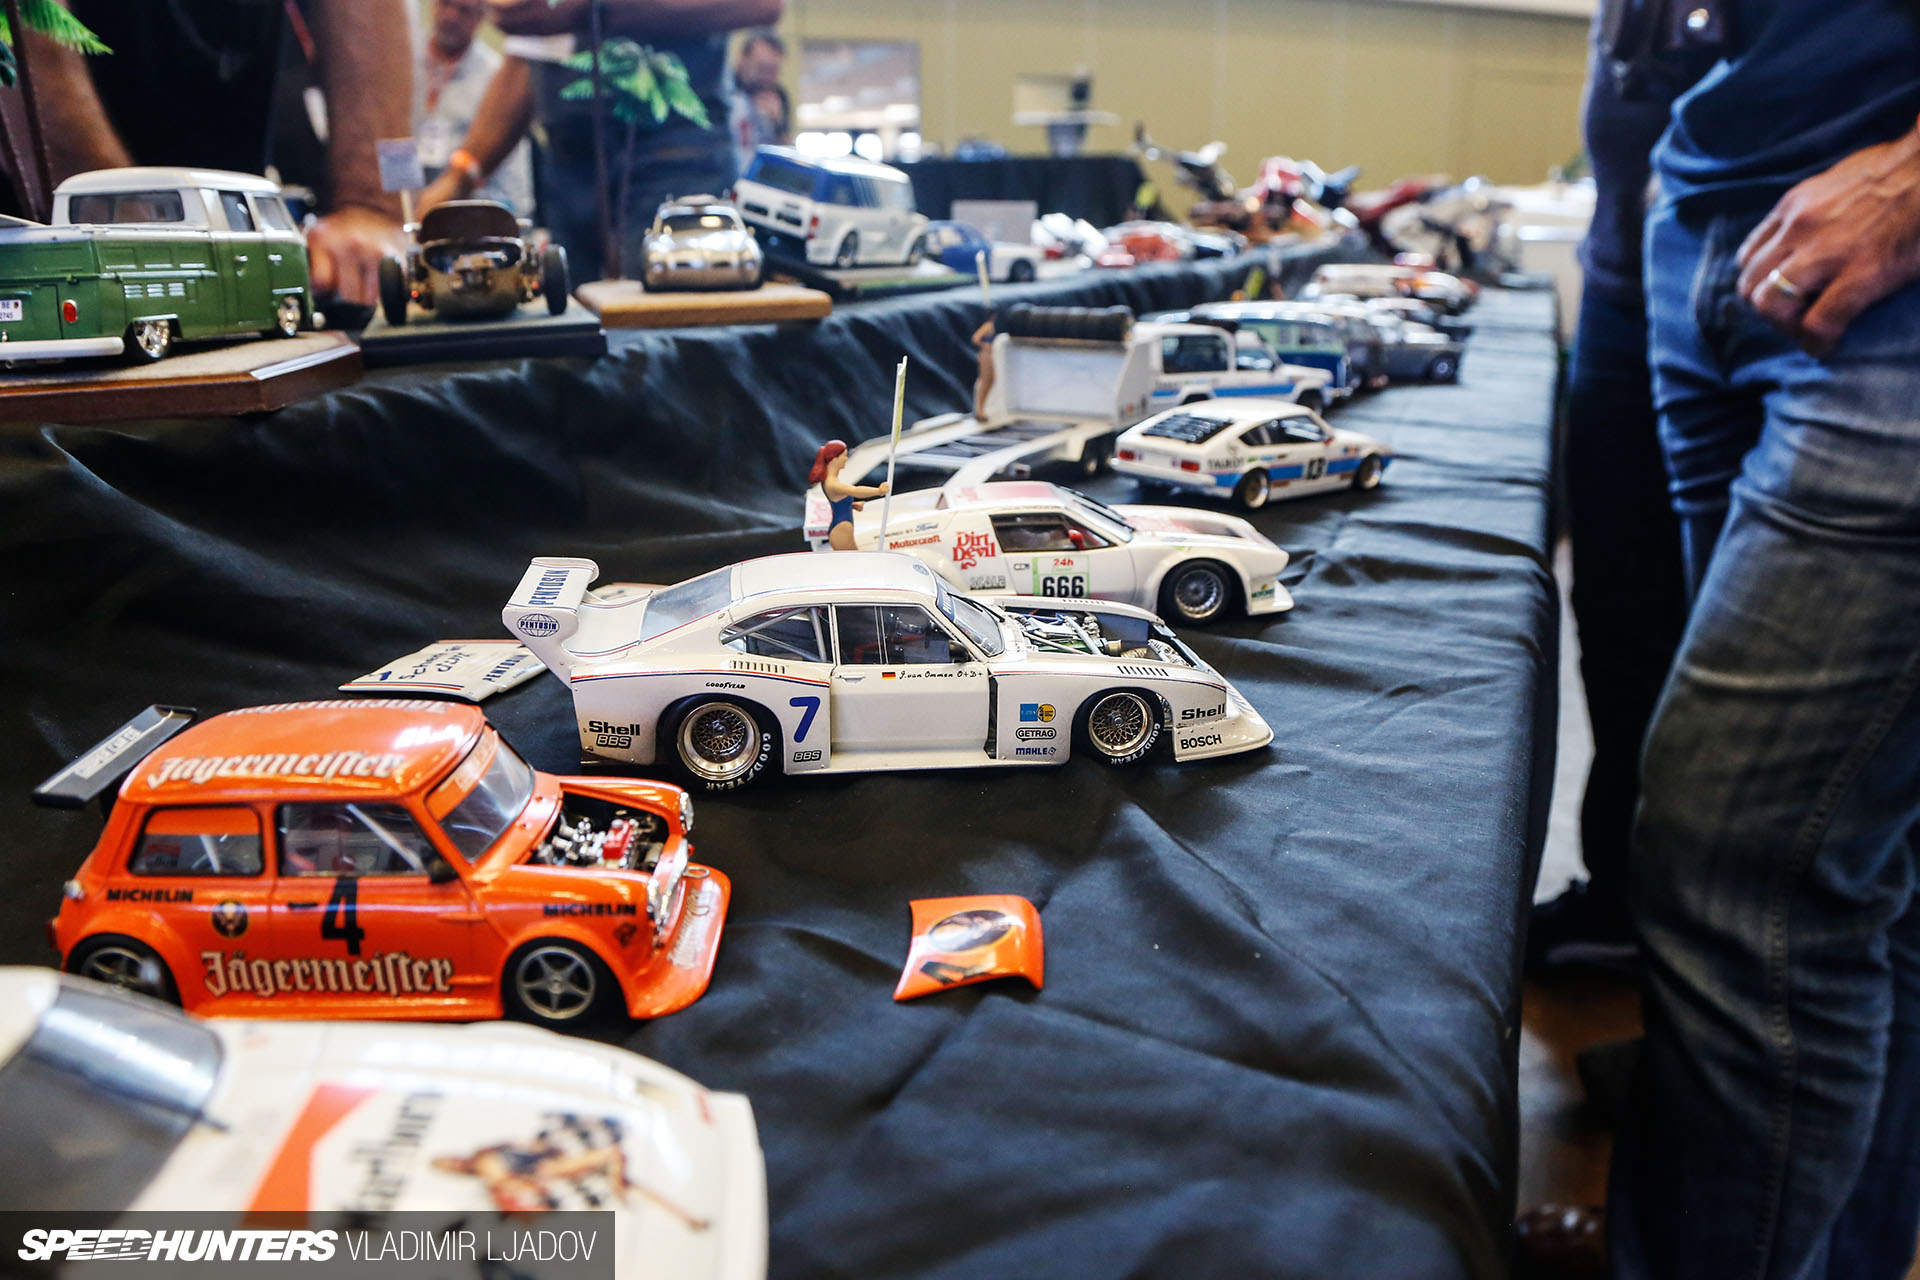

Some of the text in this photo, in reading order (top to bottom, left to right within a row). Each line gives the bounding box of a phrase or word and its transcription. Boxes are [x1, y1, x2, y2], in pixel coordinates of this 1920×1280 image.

[889, 534, 941, 550] Motorcraft
[956, 530, 989, 548] Dirt
[952, 541, 996, 562] Devil
[1053, 557, 1074, 567] 24h
[528, 569, 570, 605] PENTOSIN
[1042, 575, 1085, 598] 666
[520, 621, 557, 630] PENTOSIN
[789, 696, 821, 743] 7
[1181, 703, 1225, 720] Shell
[588, 720, 641, 736] Shell
[597, 734, 632, 748] BBS
[1180, 734, 1222, 749] BOSCH
[793, 751, 822, 762] BBS
[1015, 747, 1048, 755] MAHLE
[106, 888, 194, 904] MICHELIN
[321, 877, 366, 956] 4
[542, 903, 638, 917] MICHELIN
[200, 950, 454, 998] Jägermeister
